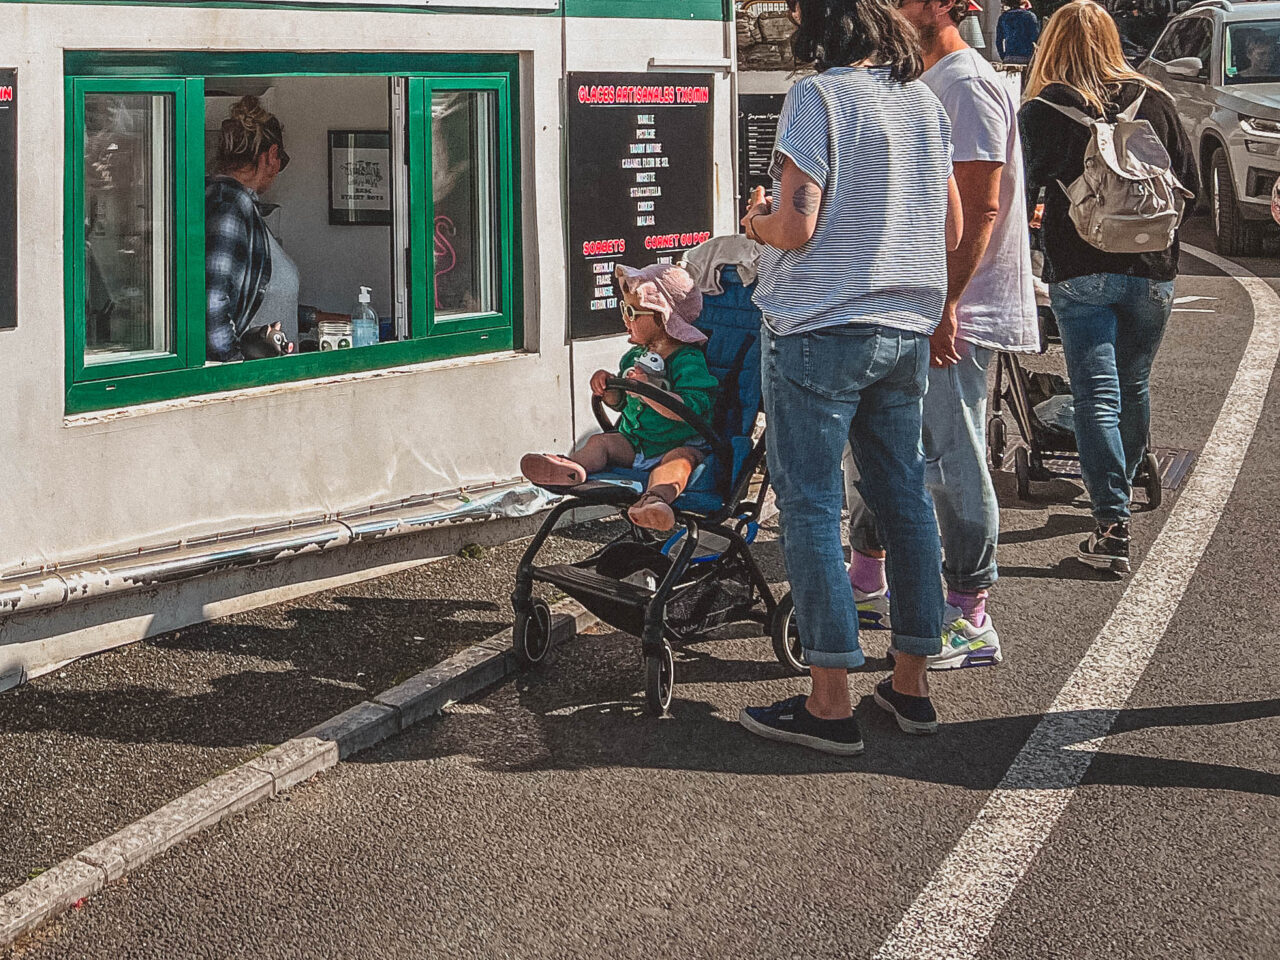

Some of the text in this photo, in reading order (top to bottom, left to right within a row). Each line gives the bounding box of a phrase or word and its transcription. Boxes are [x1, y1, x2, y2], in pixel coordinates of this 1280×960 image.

[578, 86, 709, 103] GLACES ARTISANALES TXOMIN
[583, 239, 625, 255] SORBETS
[645, 234, 680, 249] CORNET
[680, 233, 692, 246] OU
